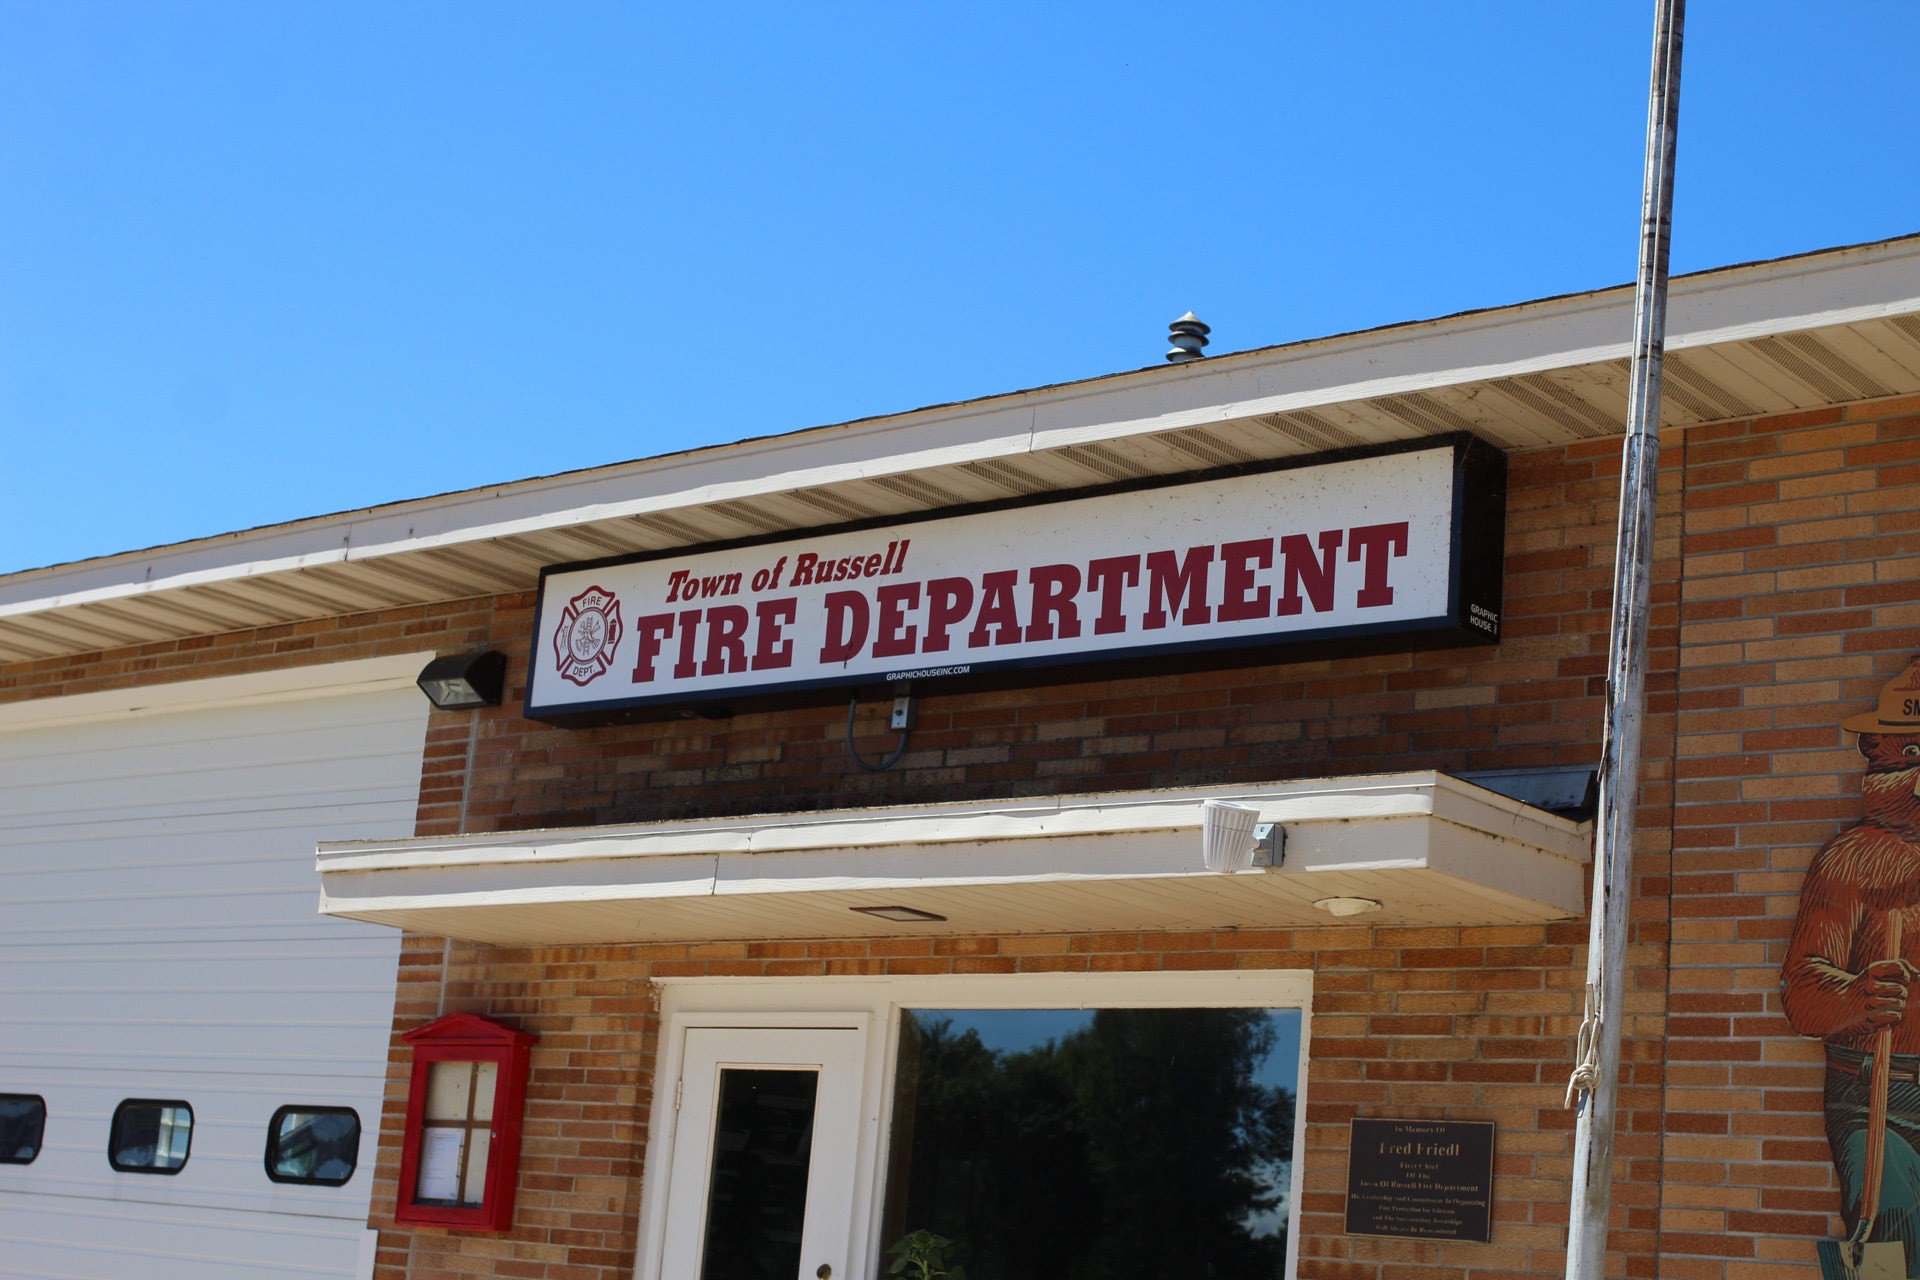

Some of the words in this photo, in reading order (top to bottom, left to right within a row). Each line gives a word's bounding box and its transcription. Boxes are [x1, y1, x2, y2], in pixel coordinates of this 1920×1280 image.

[665, 570, 743, 603] Town
[751, 556, 788, 592] of
[789, 539, 911, 587] Russell
[582, 595, 603, 608] FIRE
[631, 597, 798, 684] FIRE
[819, 521, 1409, 664] DEPARTMENT
[1470, 603, 1498, 623] GRAPHIC
[1470, 614, 1492, 633] HOUSE
[886, 665, 971, 681] GRAPHICHOUSEINC.COM
[1379, 1142, 1412, 1155] Fred
[1417, 1143, 1461, 1157] Friedl
